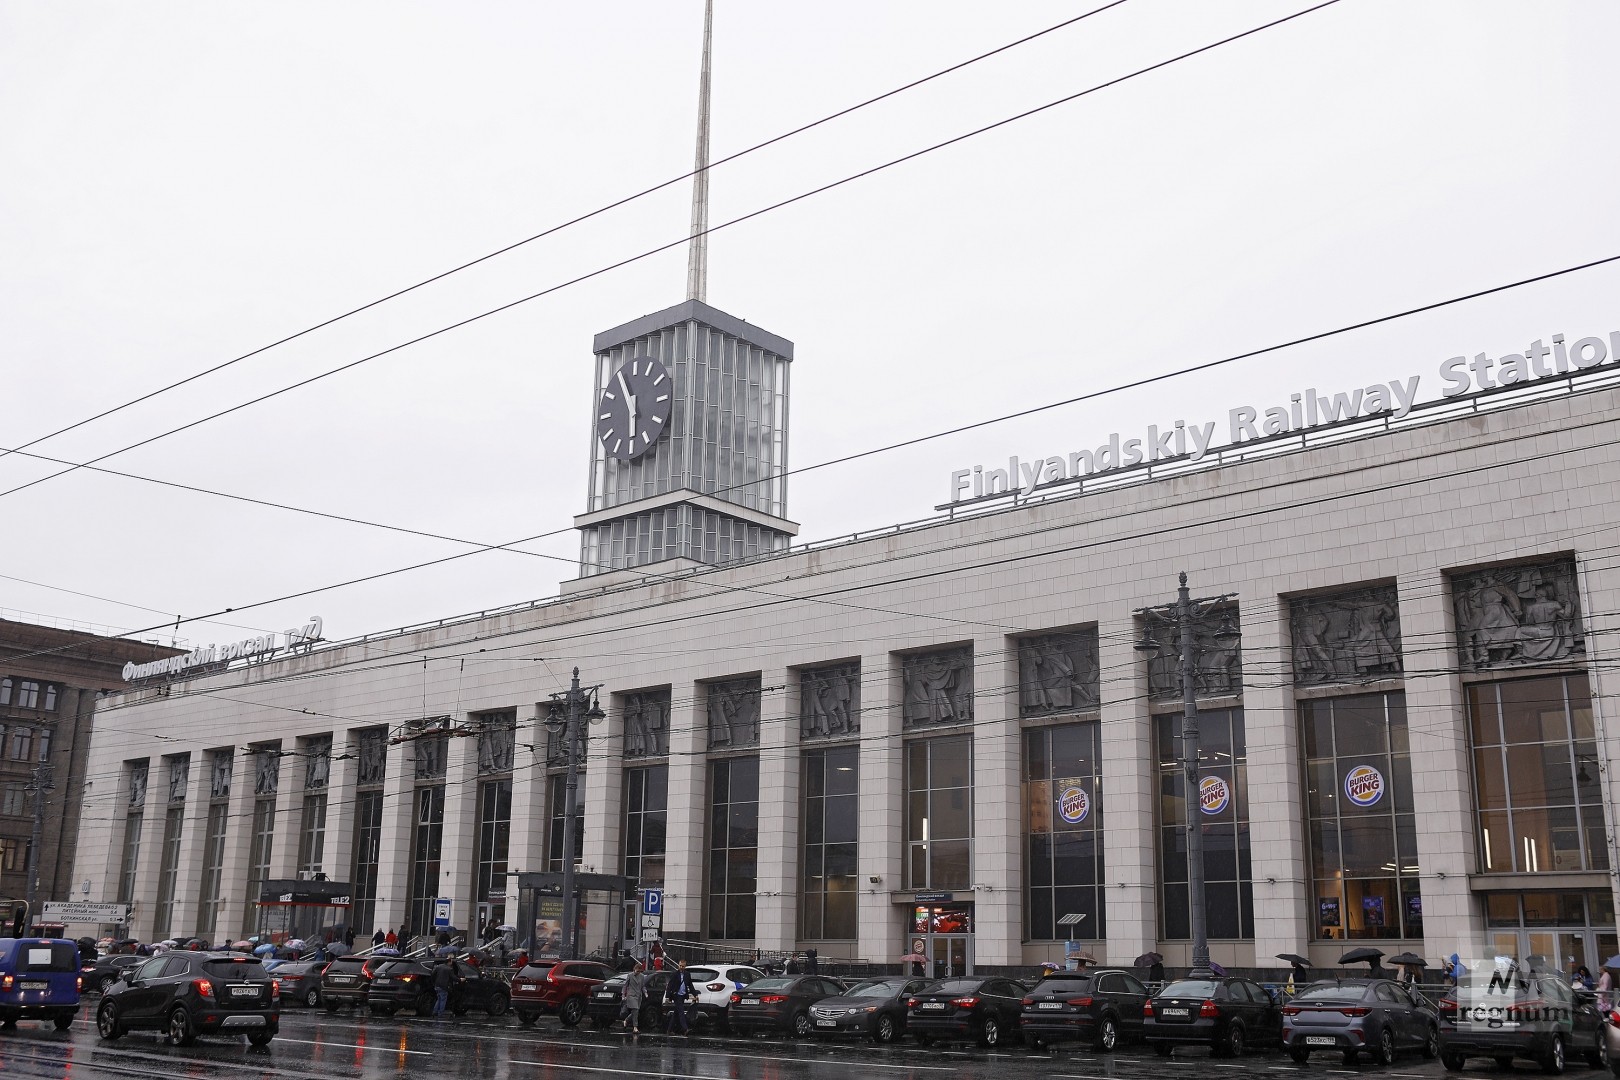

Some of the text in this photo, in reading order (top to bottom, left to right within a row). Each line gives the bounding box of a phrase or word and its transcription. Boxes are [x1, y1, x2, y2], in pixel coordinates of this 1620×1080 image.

[951, 420, 1215, 502] Finlyandskiy
[1228, 374, 1421, 444] Railway
[122, 643, 215, 682] Финляндский
[219, 634, 275, 660] вокзал
[1349, 772, 1379, 788] BURGER
[1350, 779, 1380, 797] KING
[1200, 788, 1226, 807] KING
[1063, 799, 1086, 816] KING
[331, 896, 349, 904] TELE2
[649, 893, 658, 911] P
